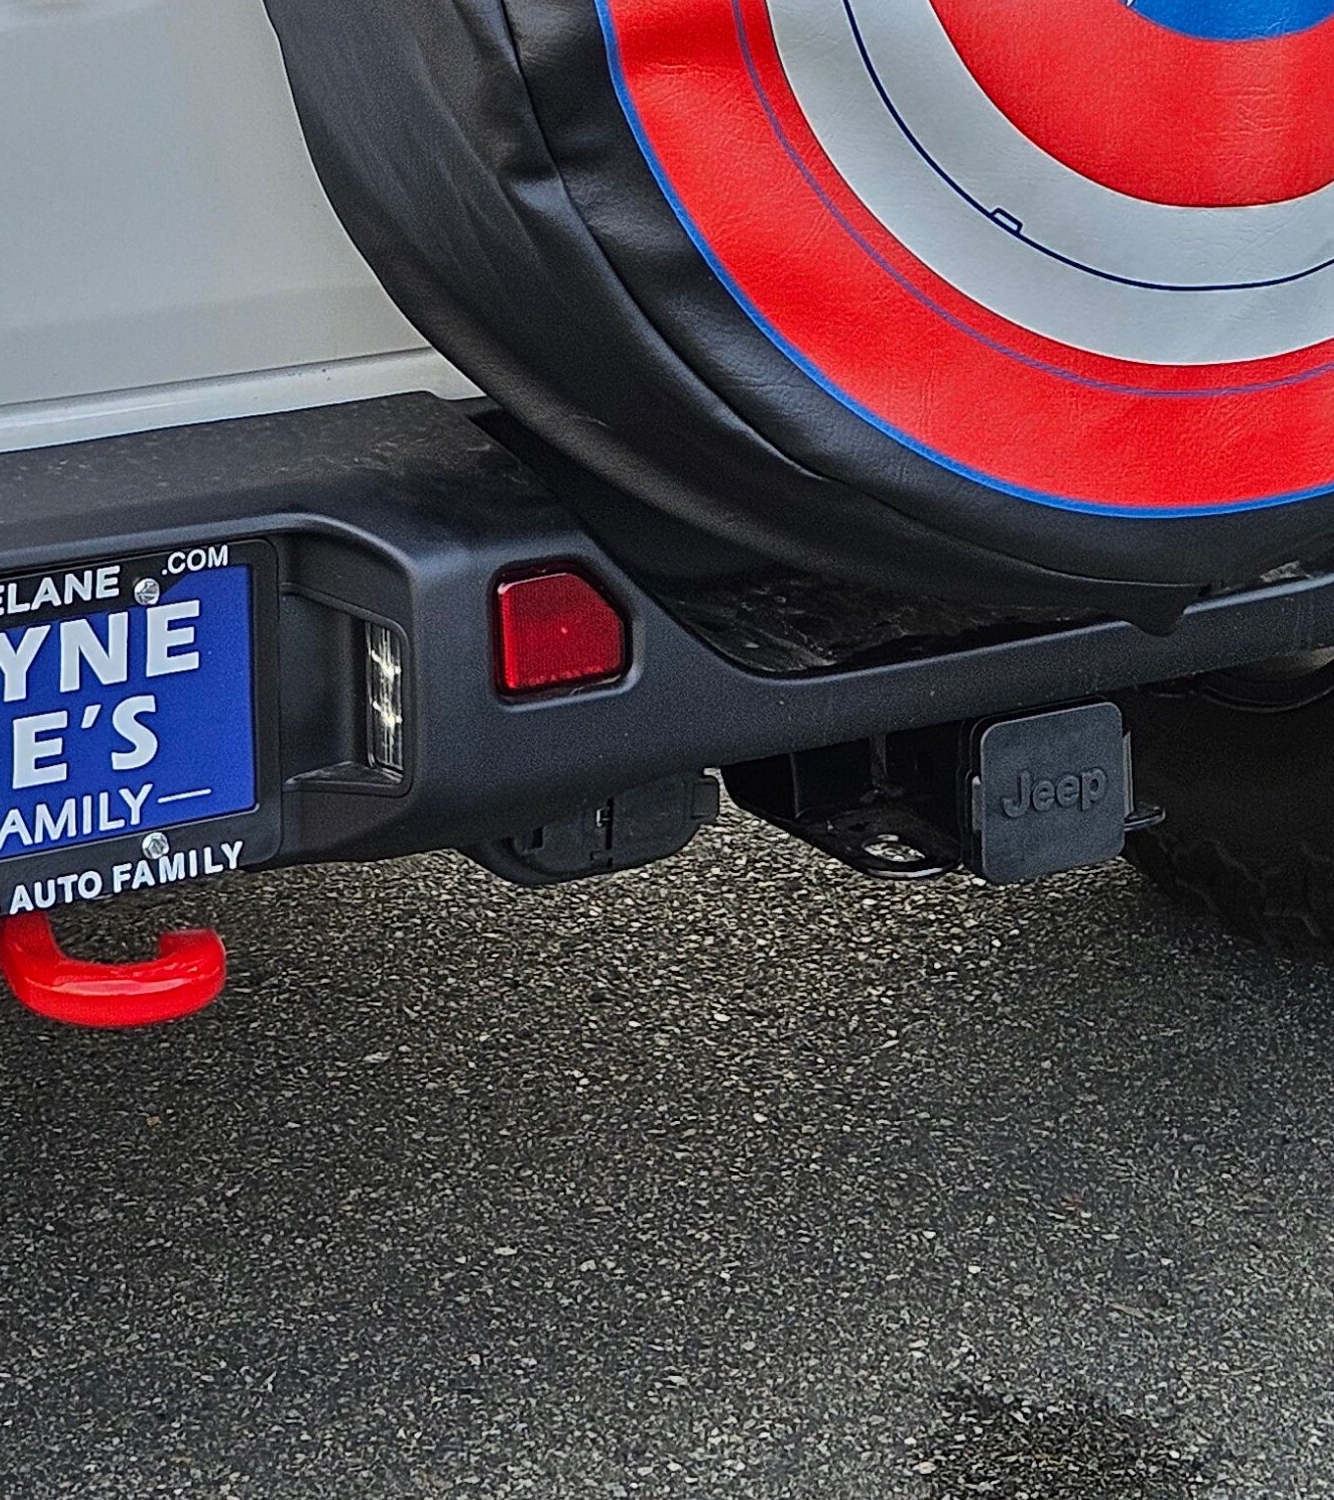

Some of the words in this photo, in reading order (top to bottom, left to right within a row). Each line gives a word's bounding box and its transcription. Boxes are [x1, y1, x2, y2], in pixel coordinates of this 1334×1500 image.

[1002, 767, 1107, 818] Jeep
[8, 869, 102, 914] AUTO
[112, 841, 243, 893] FAMILY
